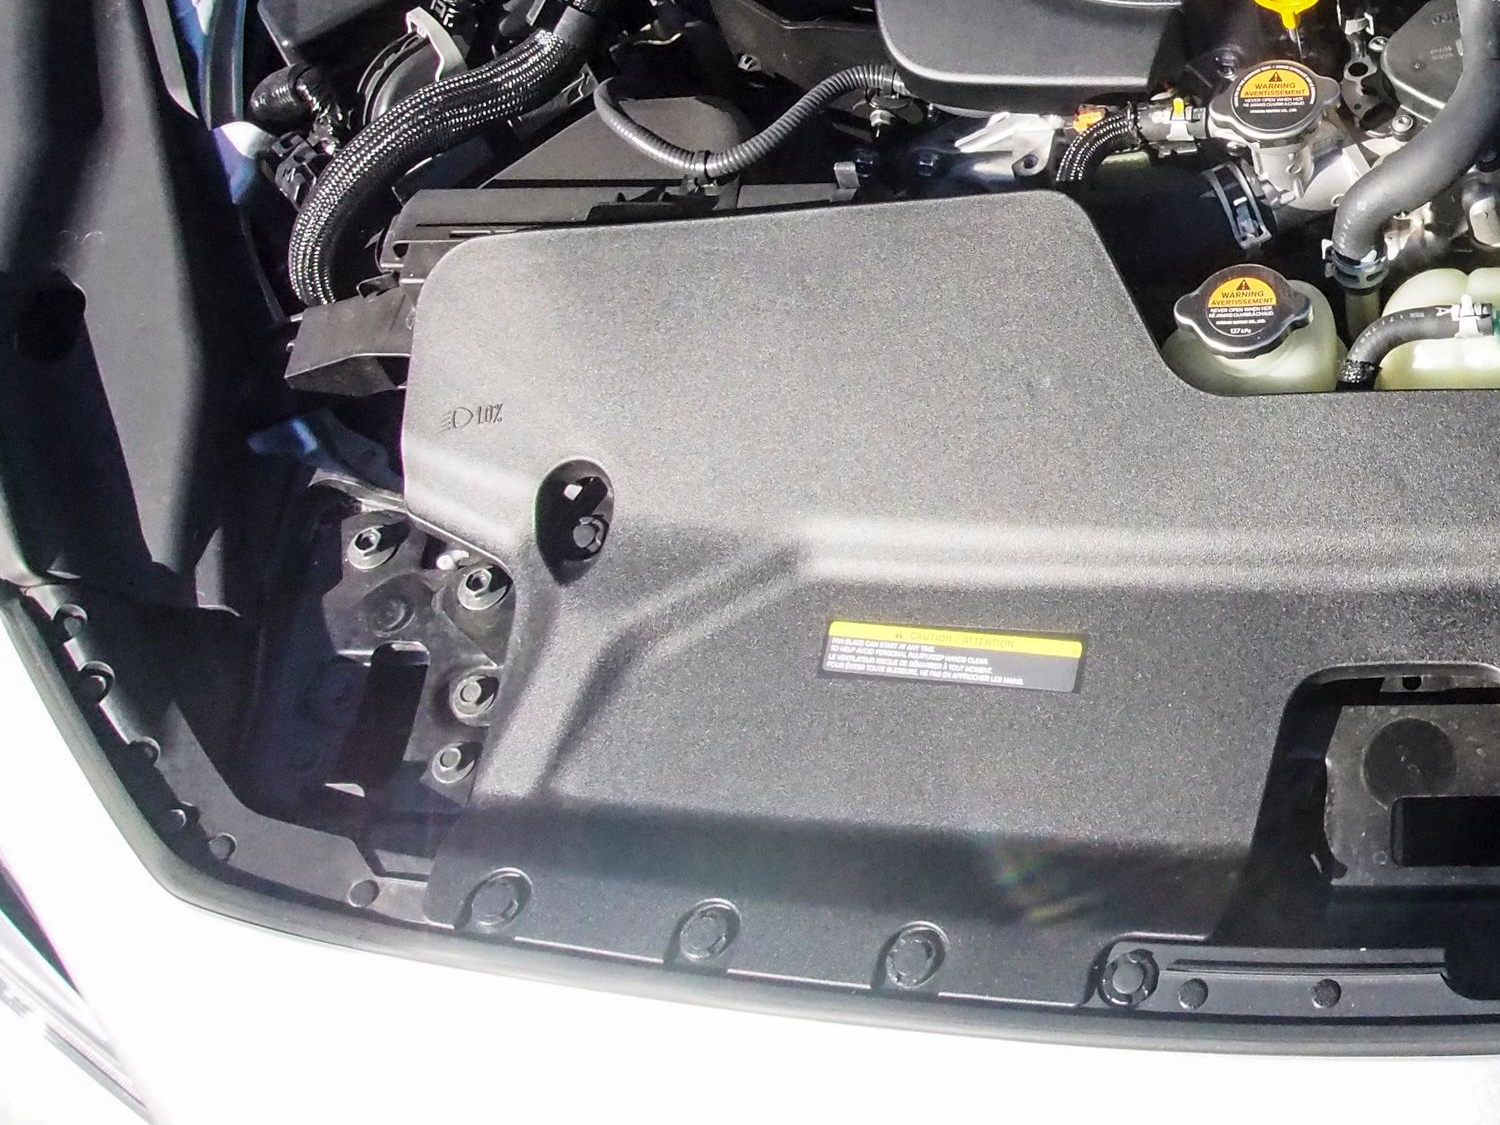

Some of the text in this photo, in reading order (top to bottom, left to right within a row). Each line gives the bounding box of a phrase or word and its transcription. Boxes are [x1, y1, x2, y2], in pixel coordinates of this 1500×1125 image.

[1221, 290, 1265, 299] WARNING
[1211, 297, 1273, 306] AVERTISSEMENT
[911, 632, 951, 642] CAUTION
[964, 637, 1013, 648] ATTENTION
